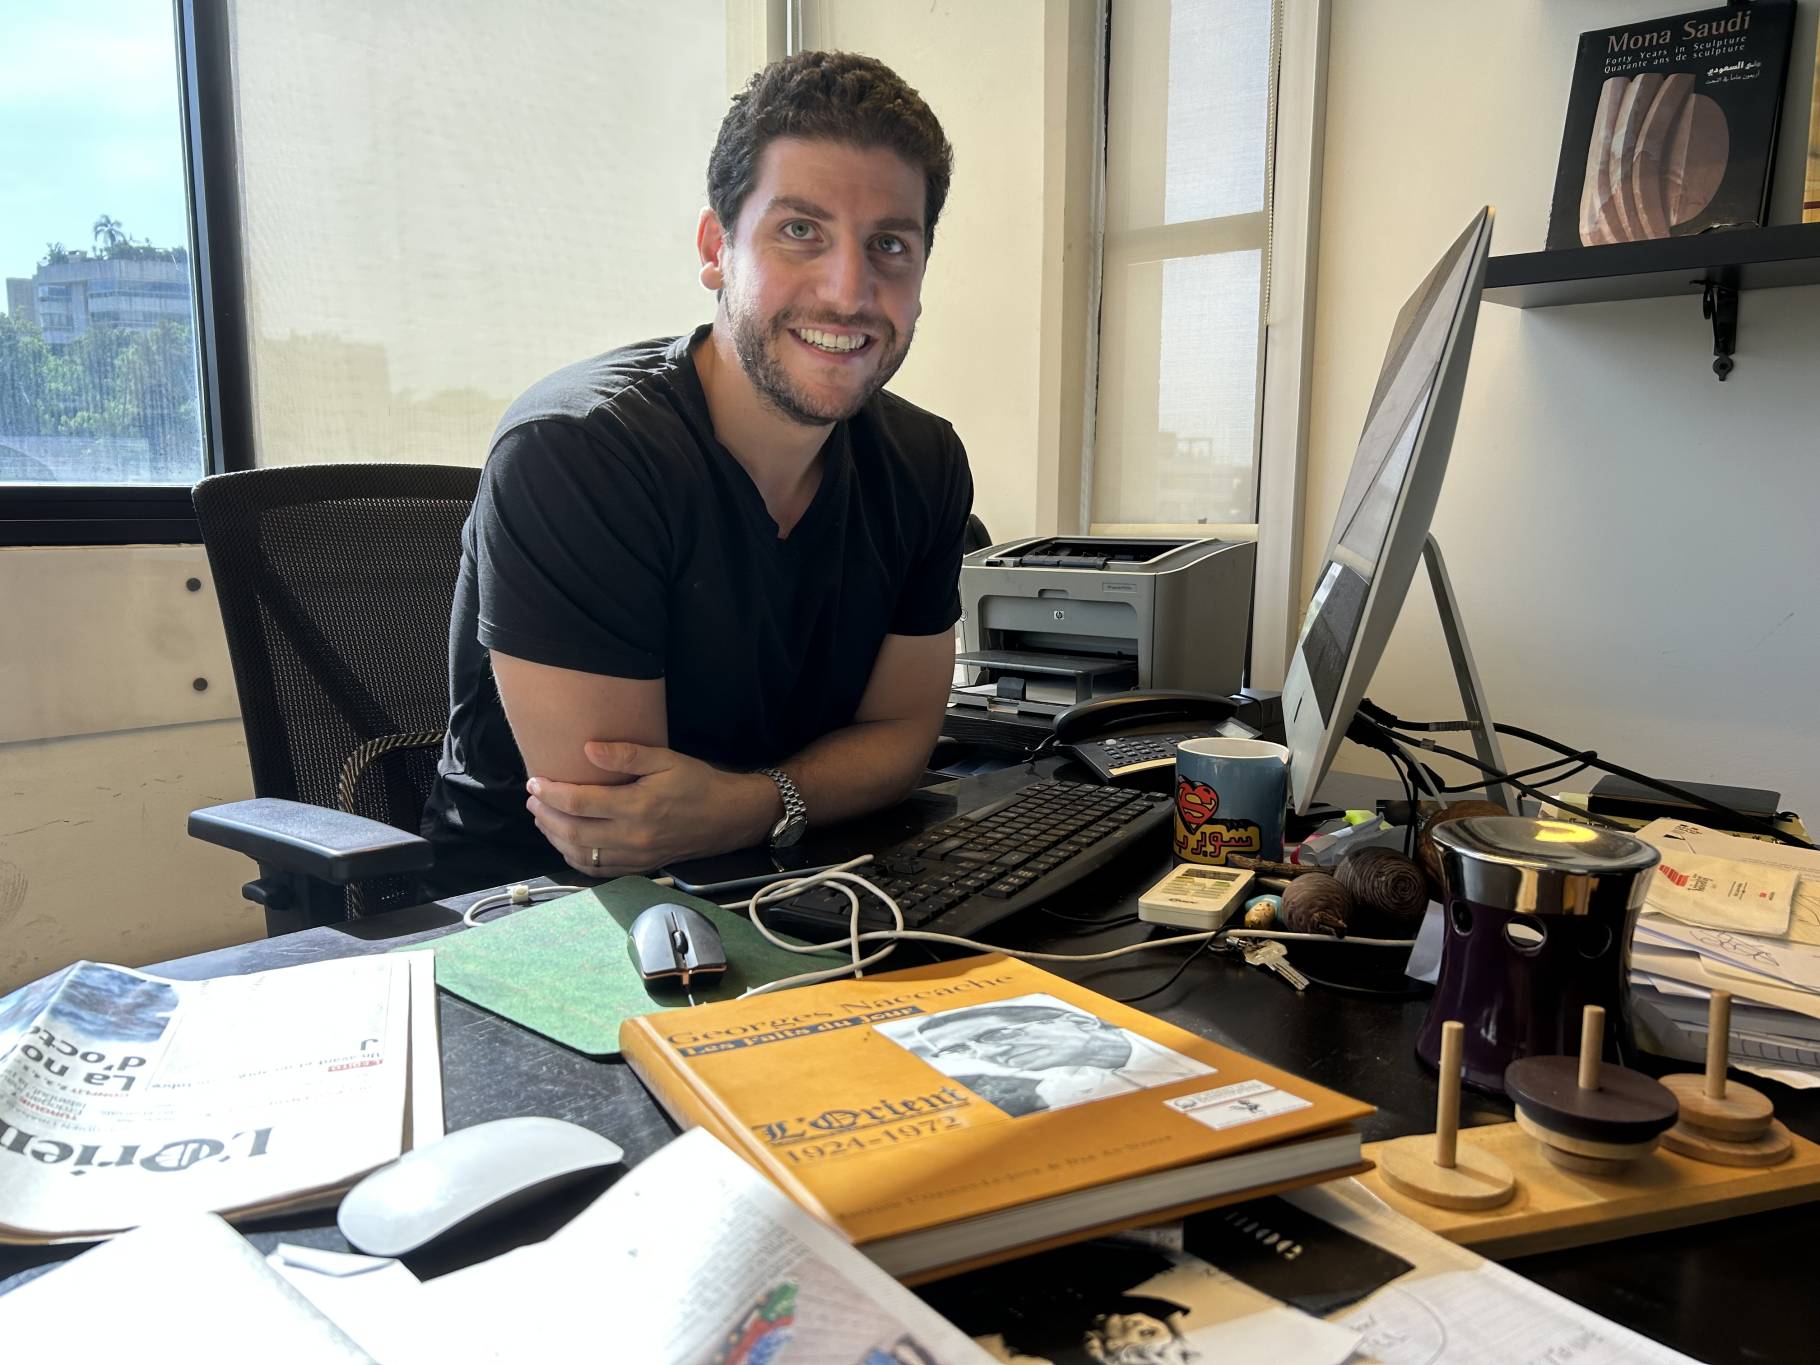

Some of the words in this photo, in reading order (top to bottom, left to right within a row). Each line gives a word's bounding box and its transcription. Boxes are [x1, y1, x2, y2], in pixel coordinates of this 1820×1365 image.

[1607, 29, 1672, 54] Mona
[1682, 10, 1752, 41] Saudi
[1604, 59, 1648, 74] Quarante
[1653, 57, 1670, 65] ans
[1675, 52, 1688, 61] de
[1693, 44, 1746, 59] sculpture
[1605, 55, 1633, 66] Forty
[1640, 49, 1668, 59] Years
[1693, 35, 1747, 50] Sculpture
[1706, 60, 1745, 76] السعودي
[1191, 831, 1253, 858] سوبر
[666, 1005, 833, 1045] Georges
[840, 974, 1013, 1013] Naccache
[686, 1038, 735, 1057] Les
[818, 1018, 851, 1033] du
[83, 1072, 137, 1092] La
[763, 1085, 970, 1145] L'Orient
[786, 1115, 957, 1165] 1924-1972
